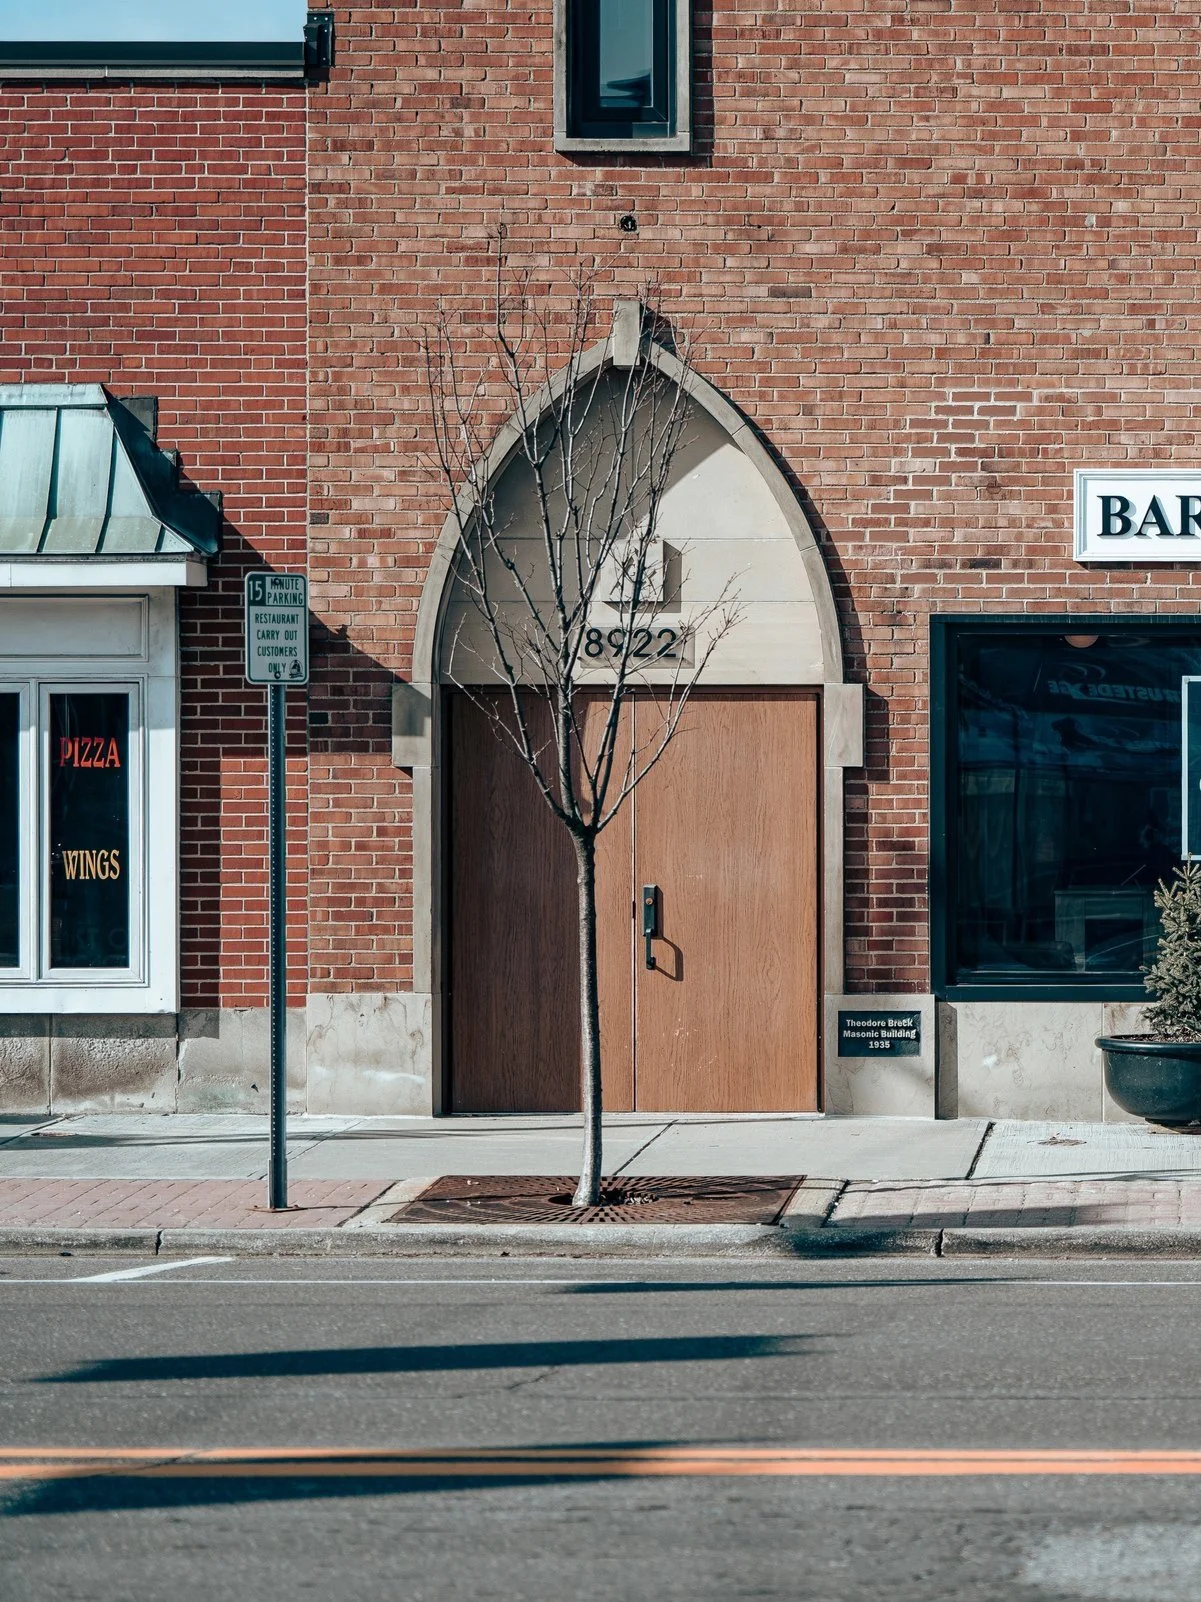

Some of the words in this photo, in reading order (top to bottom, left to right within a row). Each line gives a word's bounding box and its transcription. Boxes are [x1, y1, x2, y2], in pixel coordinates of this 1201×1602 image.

[249, 580, 263, 601] 15
[267, 592, 304, 606] PARKING
[254, 613, 299, 625] RESTAURANT
[256, 629, 281, 641] CARRY
[284, 629, 298, 641] OUT
[584, 628, 677, 658] 8922
[257, 645, 298, 657] CUSTOMERS
[268, 661, 287, 674] ONLY
[59, 736, 121, 768] PIZZA
[61, 849, 121, 880] WINGS
[845, 1019, 887, 1027] Theodore
[887, 1018, 913, 1027] Breck
[843, 1030, 880, 1038] Masonic
[880, 1029, 917, 1040] Building
[868, 1041, 891, 1049] 1935
